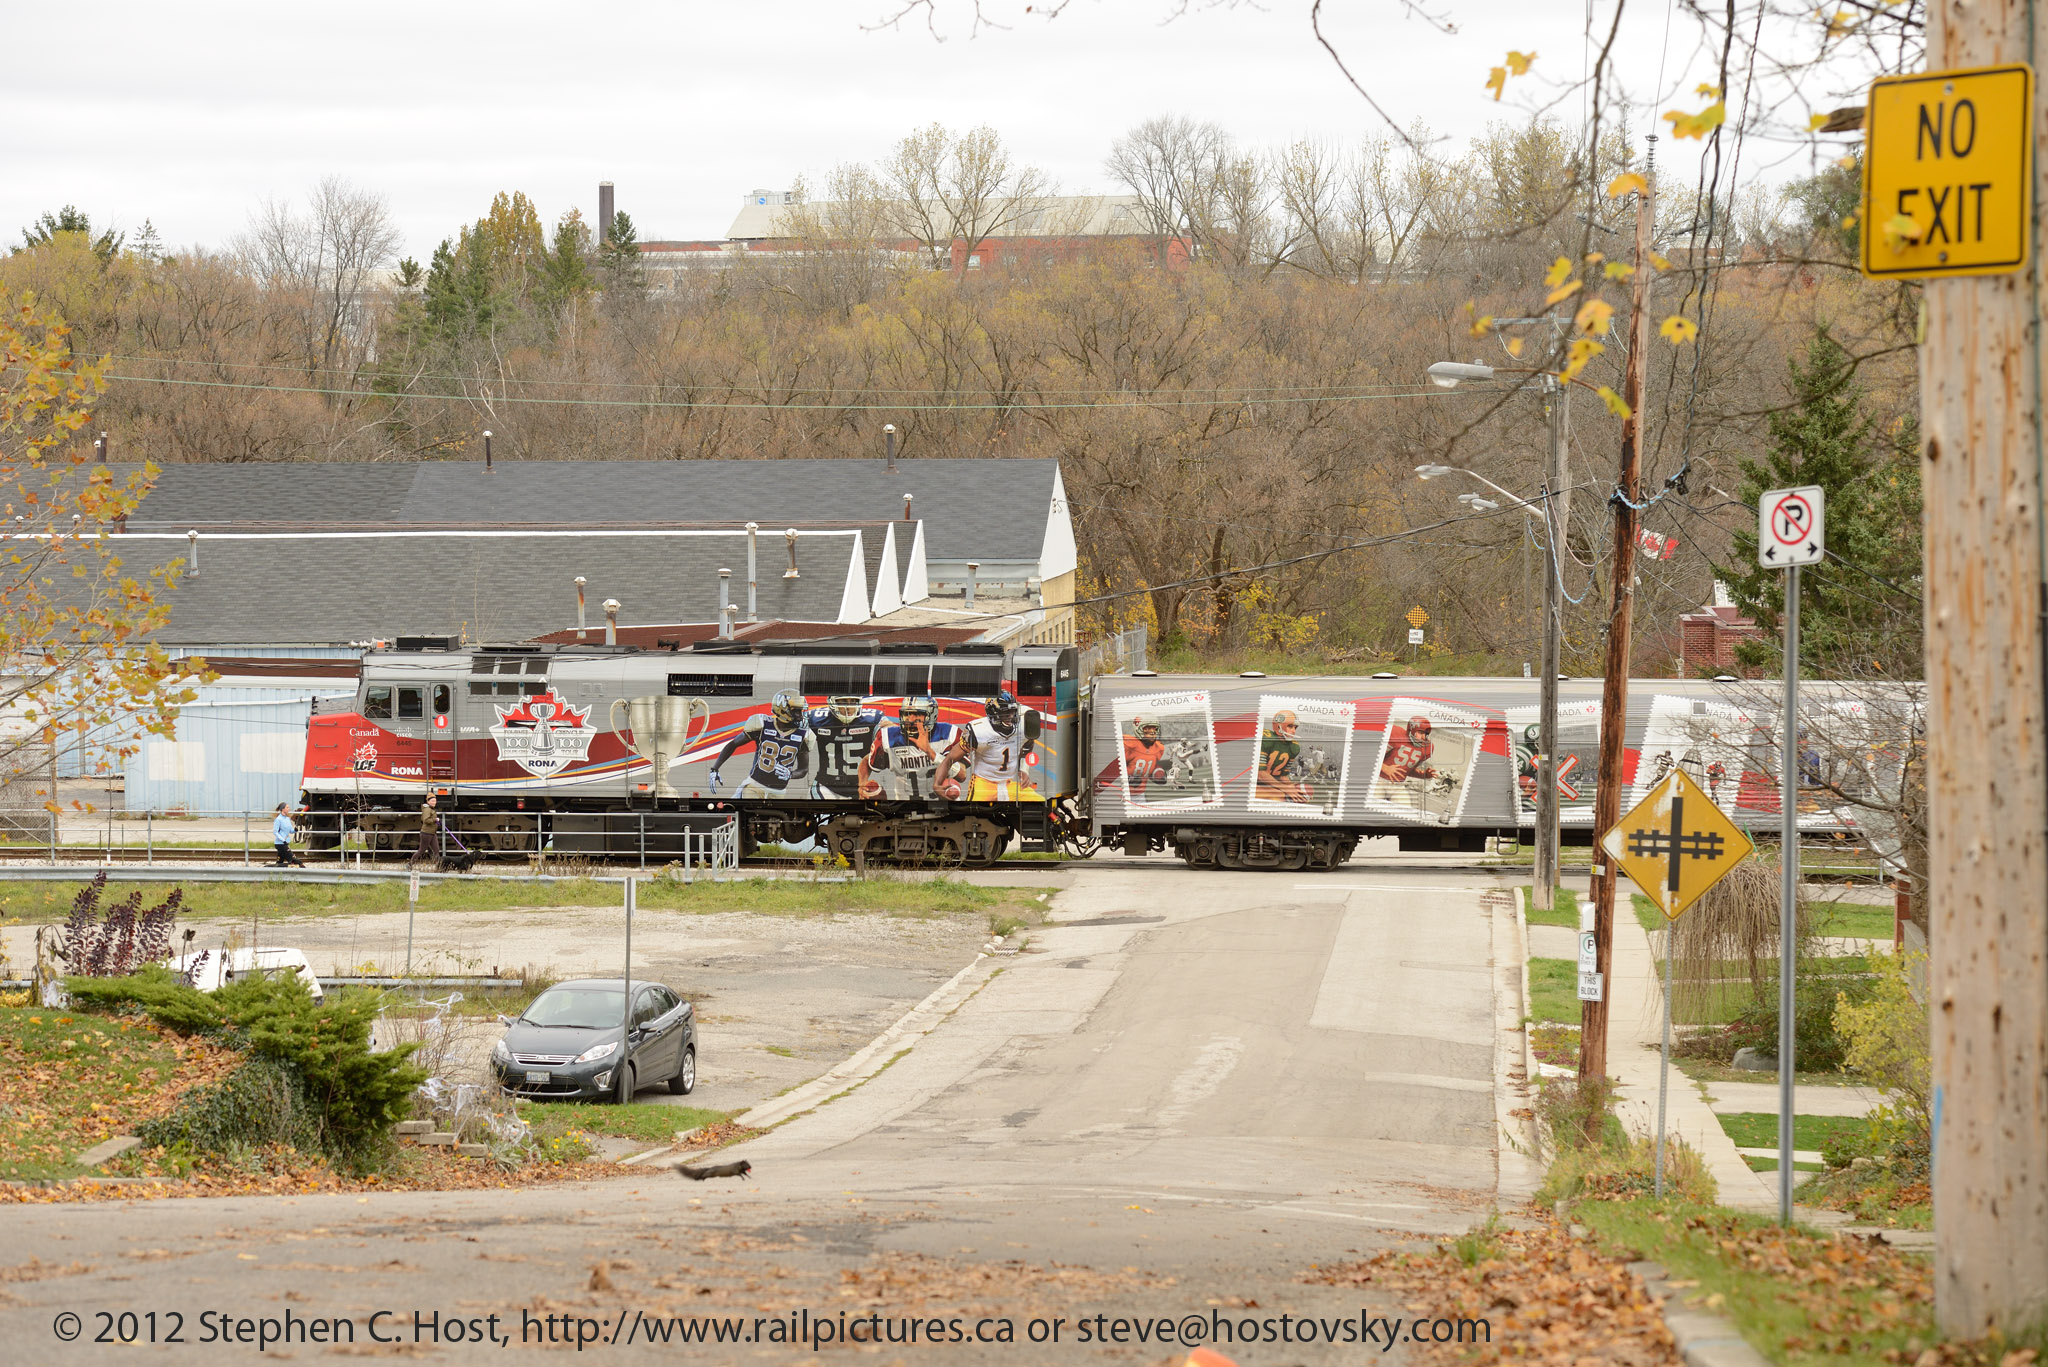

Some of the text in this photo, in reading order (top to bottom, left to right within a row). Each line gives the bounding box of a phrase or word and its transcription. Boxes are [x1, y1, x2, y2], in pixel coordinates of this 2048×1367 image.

[1917, 99, 1976, 161] NO
[1898, 183, 1992, 246] EXIT
[1151, 697, 1190, 708] CANADA
[1297, 705, 1335, 716] CANADA
[1429, 711, 1466, 726] CANADA
[349, 728, 380, 737] Canada
[504, 738, 529, 749] 100
[557, 738, 583, 749] 100
[825, 742, 865, 776] 15
[1394, 745, 1422, 769] 55
[1133, 759, 1153, 777] 81
[1266, 750, 1289, 776] 12
[391, 766, 424, 776] RONA
[1588, 939, 1594, 949] P
[1584, 976, 1597, 986] THIS
[1580, 986, 1599, 997] BLOCK
